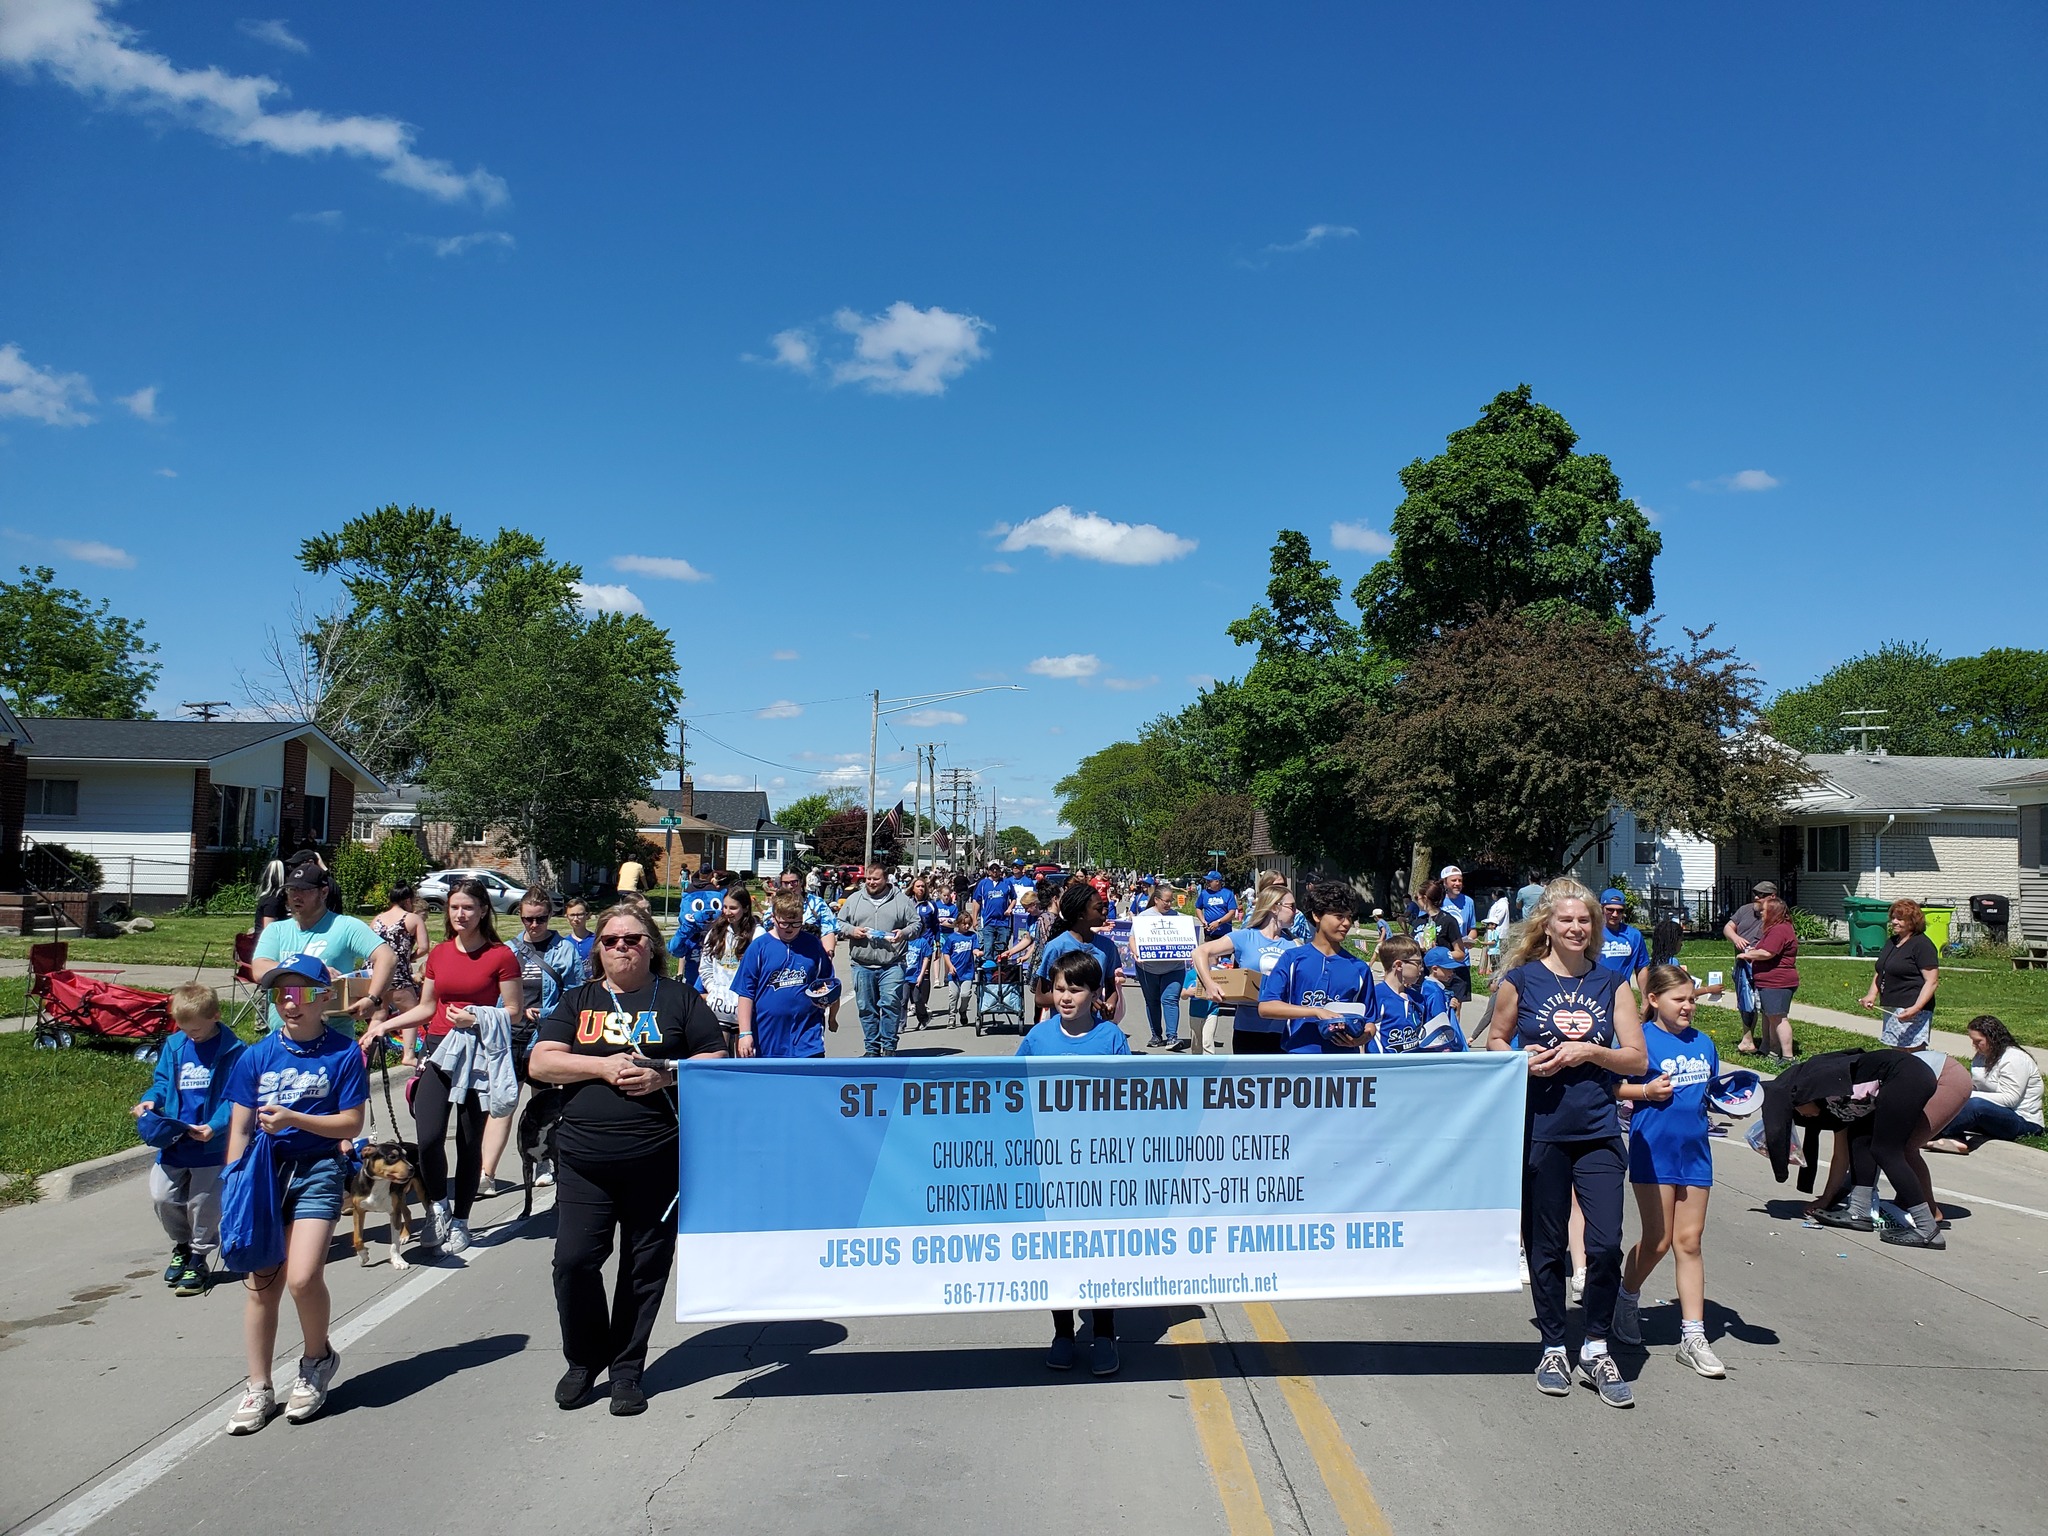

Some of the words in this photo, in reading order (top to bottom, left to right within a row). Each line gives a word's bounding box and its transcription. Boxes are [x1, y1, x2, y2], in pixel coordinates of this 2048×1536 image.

[1158, 950, 1191, 958] 777-630
[1535, 992, 1564, 1022] FAITH
[1571, 991, 1607, 1023] FAMILY
[577, 1009, 663, 1045] USA
[840, 1083, 887, 1117] ST.
[903, 1080, 1024, 1116] PETER'S
[1038, 1077, 1188, 1112] LUTHERAN
[1203, 1076, 1378, 1110] EASTPOINTE
[933, 1140, 998, 1169] CHURCH,
[1005, 1138, 1063, 1167] SCHOOL
[1070, 1138, 1082, 1165] &
[1090, 1137, 1136, 1165] EARLY
[1142, 1135, 1225, 1163] CHILDHOOD
[1232, 1134, 1290, 1161] CENTER
[926, 1182, 1007, 1213] CHRISTIAN
[1015, 1180, 1102, 1209] EDUCATION
[1110, 1179, 1137, 1207] FOR
[1145, 1176, 1249, 1206] INFANTS-8TH
[1256, 1176, 1305, 1203] GRADE
[819, 1237, 900, 1268] JESUS
[912, 1233, 1000, 1264] GROWS
[1012, 1227, 1177, 1261] GENERATIONS
[1188, 1226, 1217, 1254] OF
[1227, 1223, 1335, 1253] FAMILIES
[1346, 1221, 1404, 1250] HERE
[944, 1279, 1049, 1305] 586-777-6300
[1079, 1272, 1278, 1303] stpeterslutheranchurch.net
